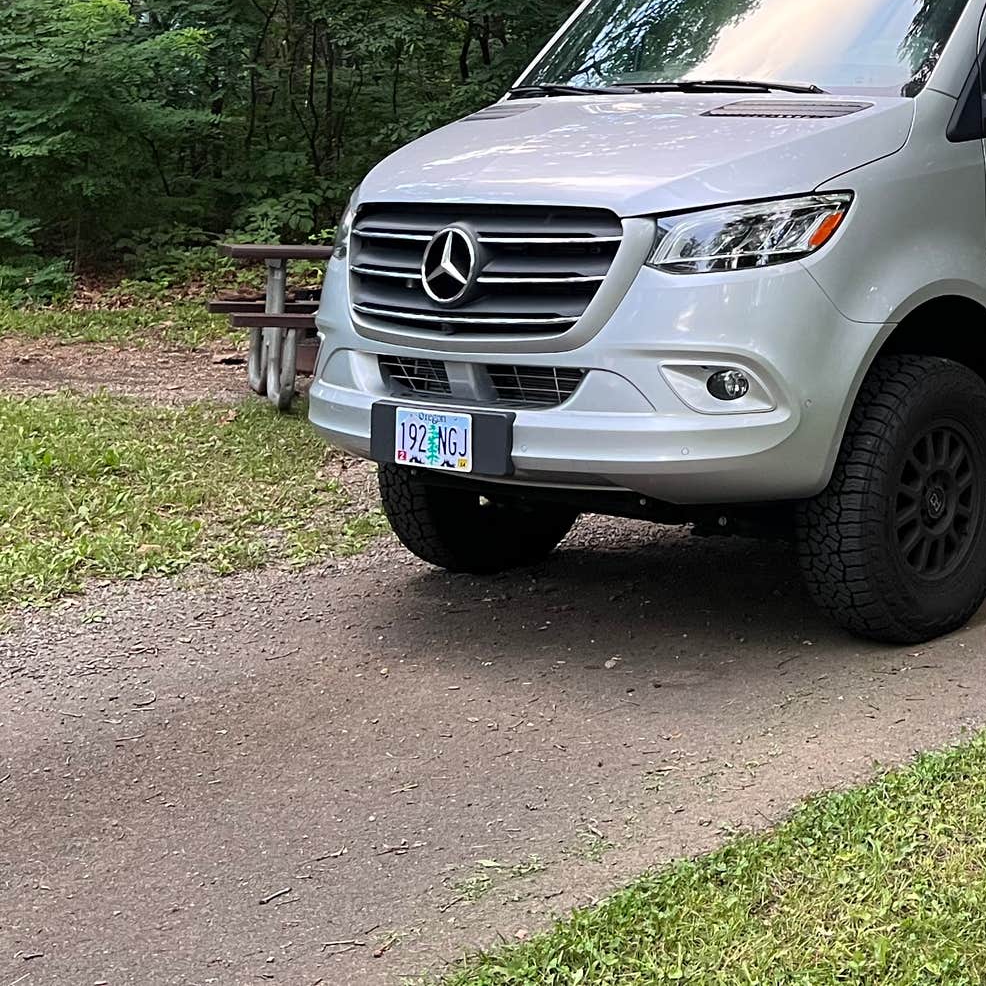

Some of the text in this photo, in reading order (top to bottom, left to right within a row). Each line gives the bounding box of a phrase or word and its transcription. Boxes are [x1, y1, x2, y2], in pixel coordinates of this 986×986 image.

[418, 412, 447, 424] Oregon
[401, 422, 467, 457] 192 NGJ
